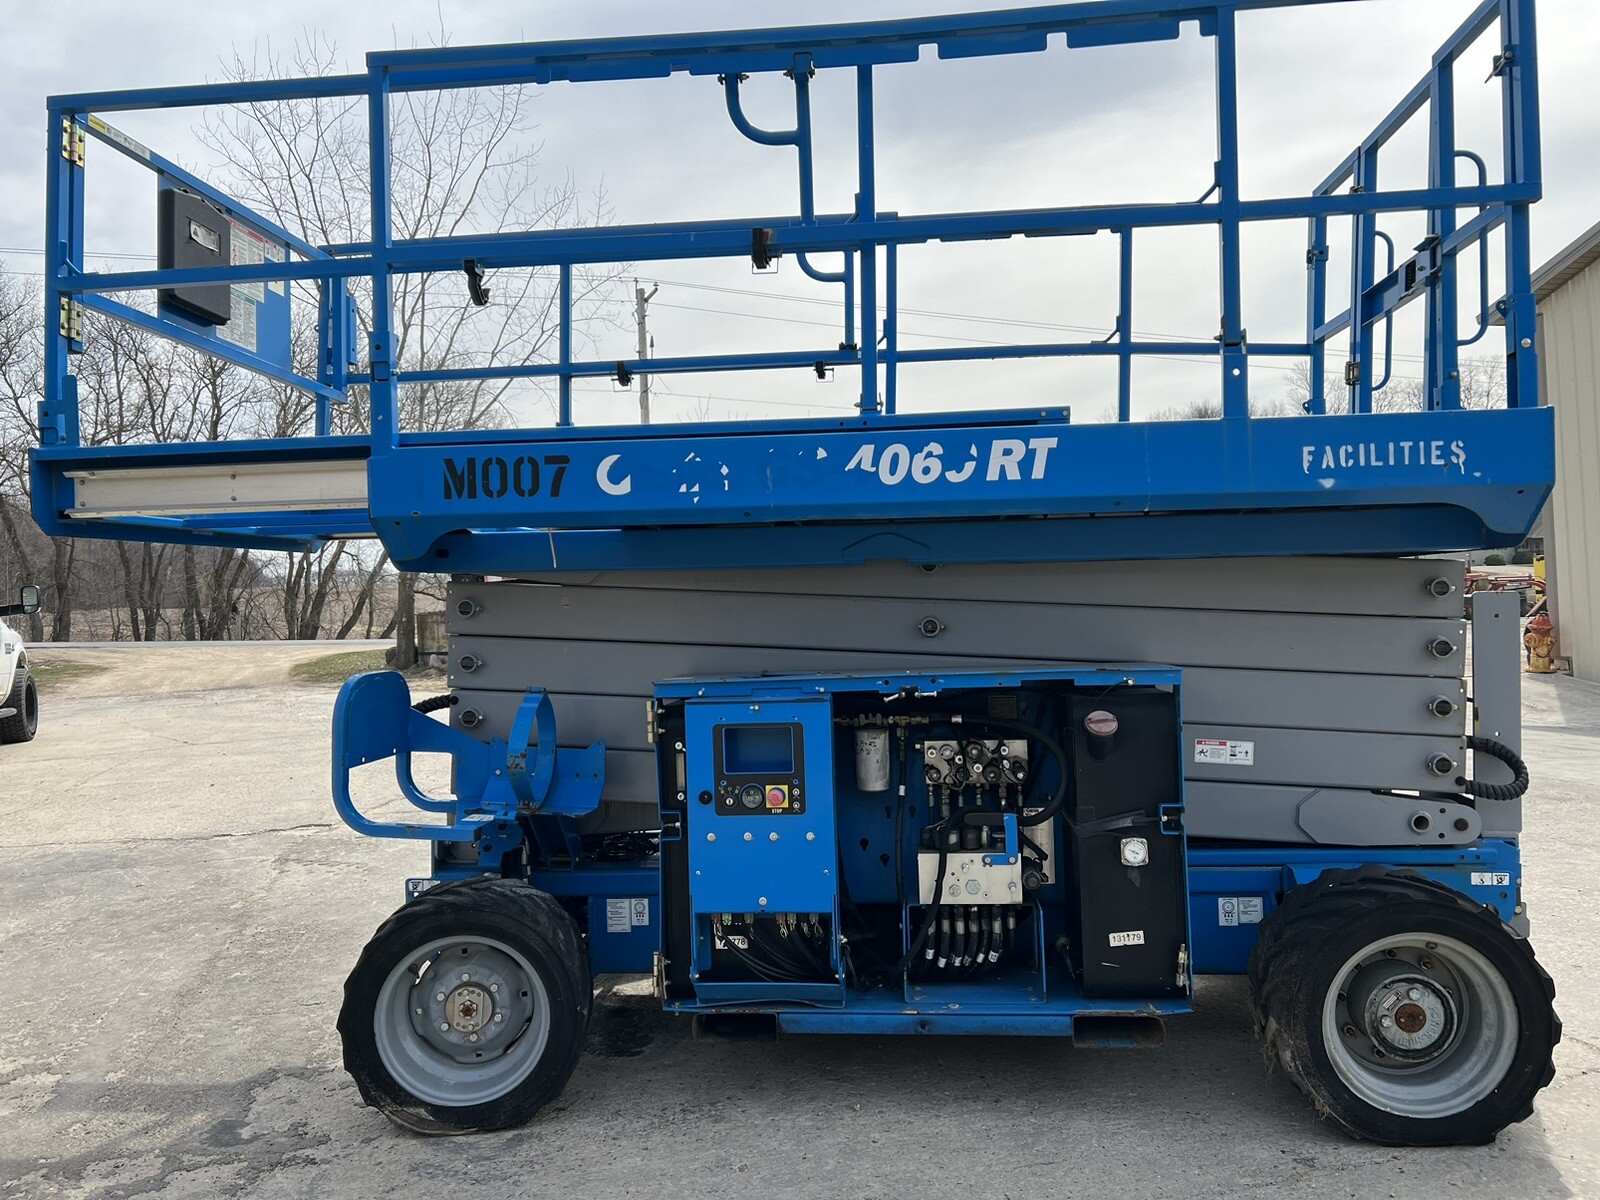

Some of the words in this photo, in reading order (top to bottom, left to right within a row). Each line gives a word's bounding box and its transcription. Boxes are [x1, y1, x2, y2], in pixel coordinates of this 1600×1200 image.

[443, 455, 570, 500] M007
[986, 437, 1058, 481] RT
[1302, 440, 1467, 473] FACILITIES
